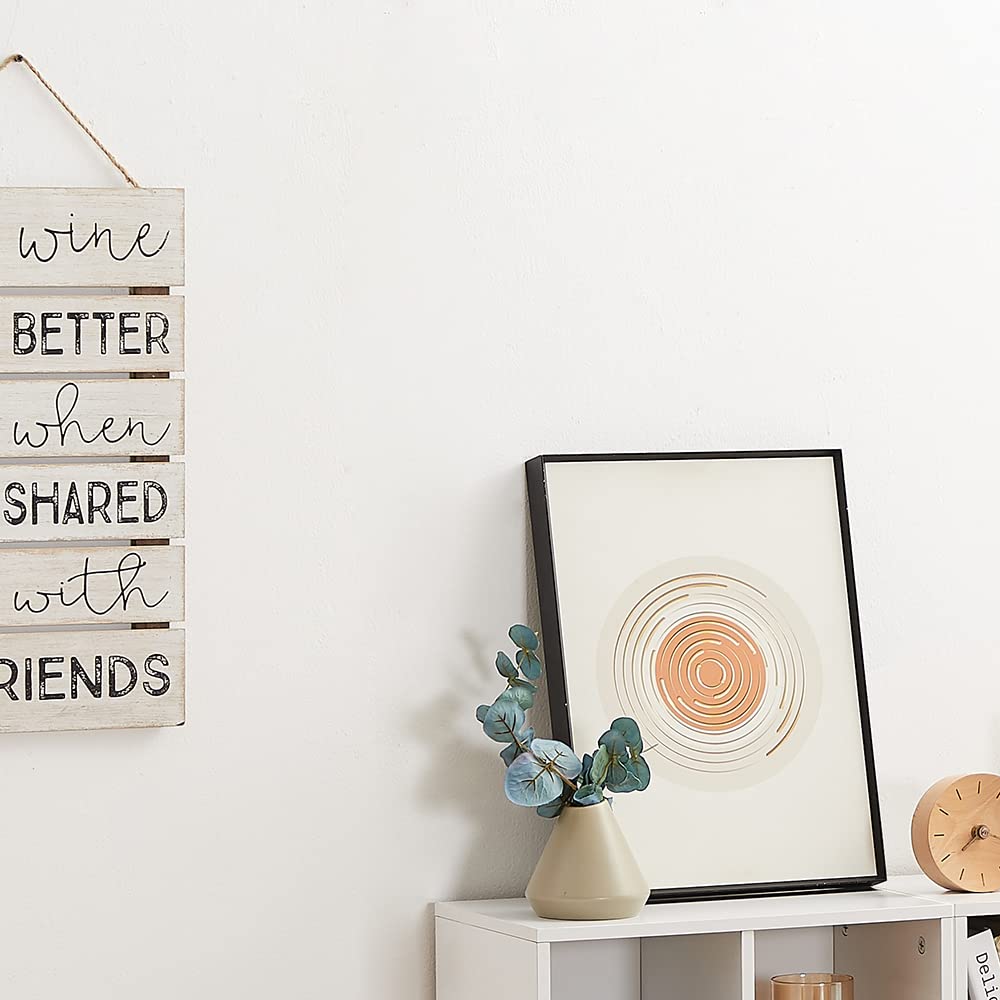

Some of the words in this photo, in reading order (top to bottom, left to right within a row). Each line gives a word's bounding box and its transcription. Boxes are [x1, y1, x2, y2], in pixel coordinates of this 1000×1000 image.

[19, 212, 170, 263] wine
[13, 311, 170, 355] BETTER
[13, 382, 171, 448] when
[3, 480, 168, 526] SHARED
[14, 552, 169, 615] with
